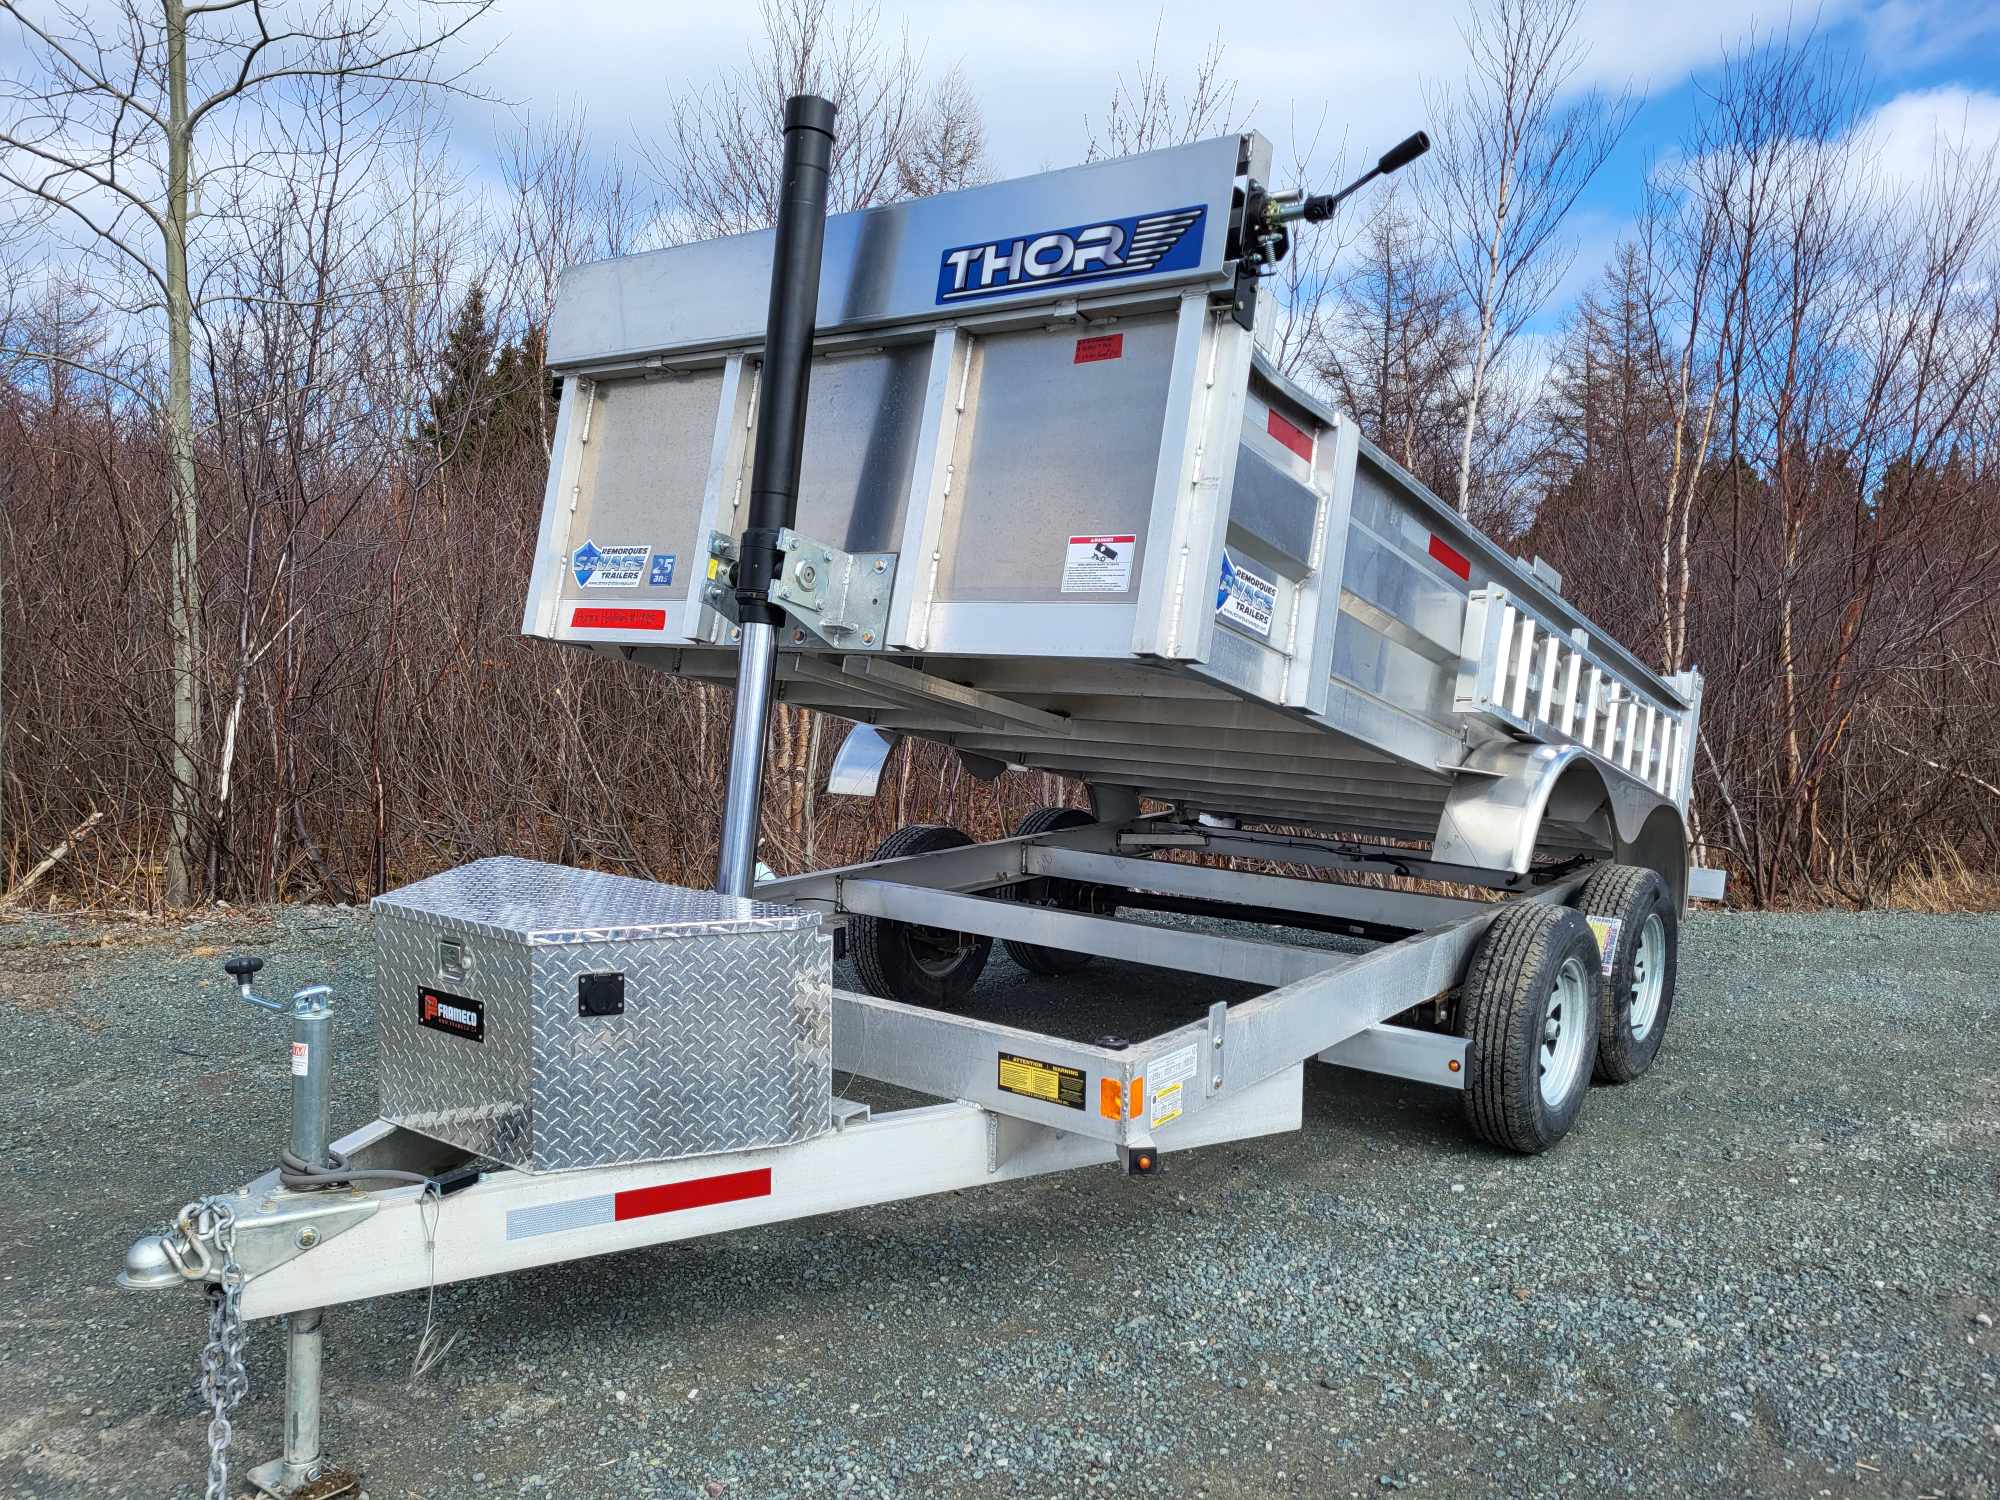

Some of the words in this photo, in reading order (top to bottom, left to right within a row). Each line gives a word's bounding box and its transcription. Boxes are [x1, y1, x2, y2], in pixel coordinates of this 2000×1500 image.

[946, 225, 1125, 289] THOR
[601, 547, 649, 555] REMORQUES
[652, 558, 674, 574] 25
[601, 572, 640, 580] TRAILERS
[652, 574, 668, 583] ans
[1236, 569, 1277, 597] REMORQUES
[1235, 602, 1269, 625] TRAILERS
[437, 1003, 477, 1027] FRAMECO
